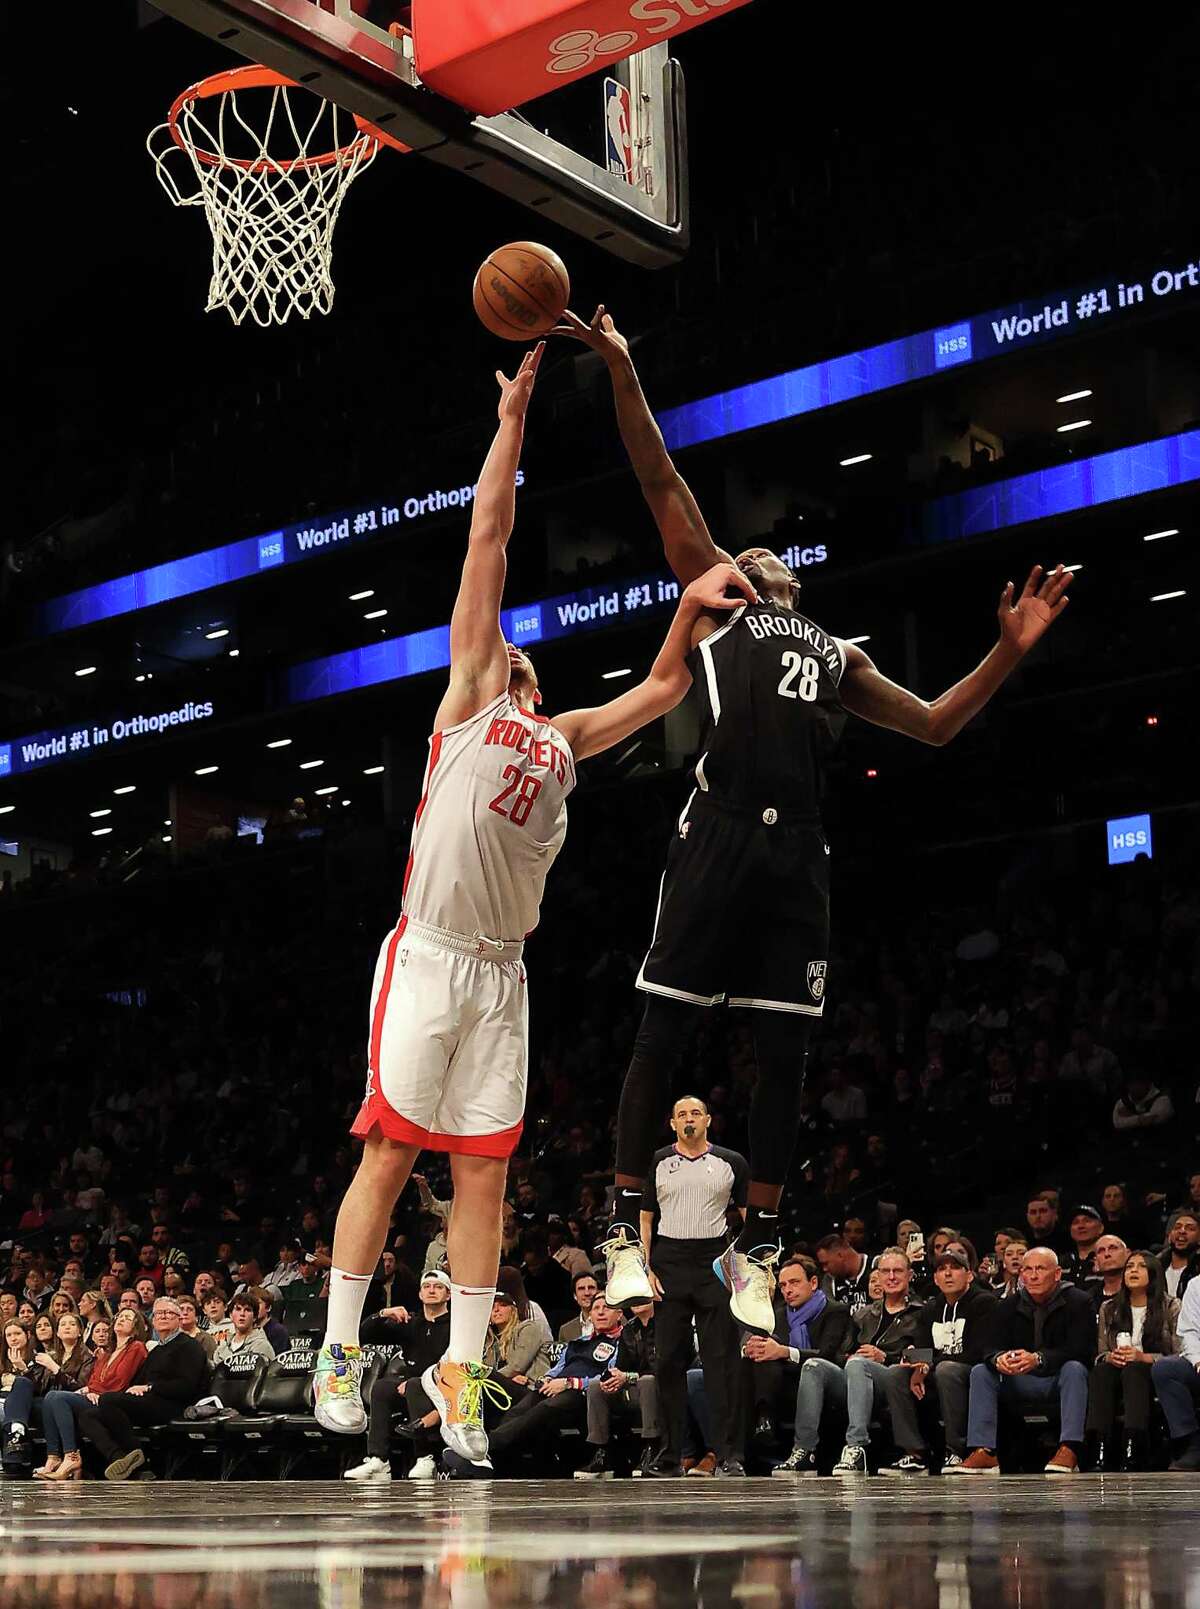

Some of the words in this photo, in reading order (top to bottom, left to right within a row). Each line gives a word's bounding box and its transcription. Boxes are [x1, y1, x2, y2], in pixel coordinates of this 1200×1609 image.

[629, 0, 731, 34] St
[938, 336, 968, 355] HSS
[991, 300, 1069, 344] World
[1075, 288, 1112, 320] #1
[1117, 283, 1144, 307] in
[1151, 258, 1200, 296] Ort
[296, 518, 350, 551] World
[352, 510, 378, 535] #1
[381, 506, 400, 527] in
[557, 597, 619, 627] World
[623, 584, 653, 611] #1
[657, 580, 679, 602] in
[744, 614, 840, 671] BROOKLYN
[777, 650, 820, 702] 28
[21, 735, 67, 763] World
[69, 729, 91, 751] #1
[93, 726, 109, 745] in
[111, 701, 214, 740] Orthopedics
[484, 718, 568, 786] ROCKETS
[488, 764, 543, 827] 28
[1112, 829, 1147, 849] HSS
[224, 1354, 259, 1367] QATAR
[230, 1363, 256, 1373] AIRWAYS
[277, 1352, 314, 1365] QATAR
[283, 1361, 311, 1370] AIRWAYS
